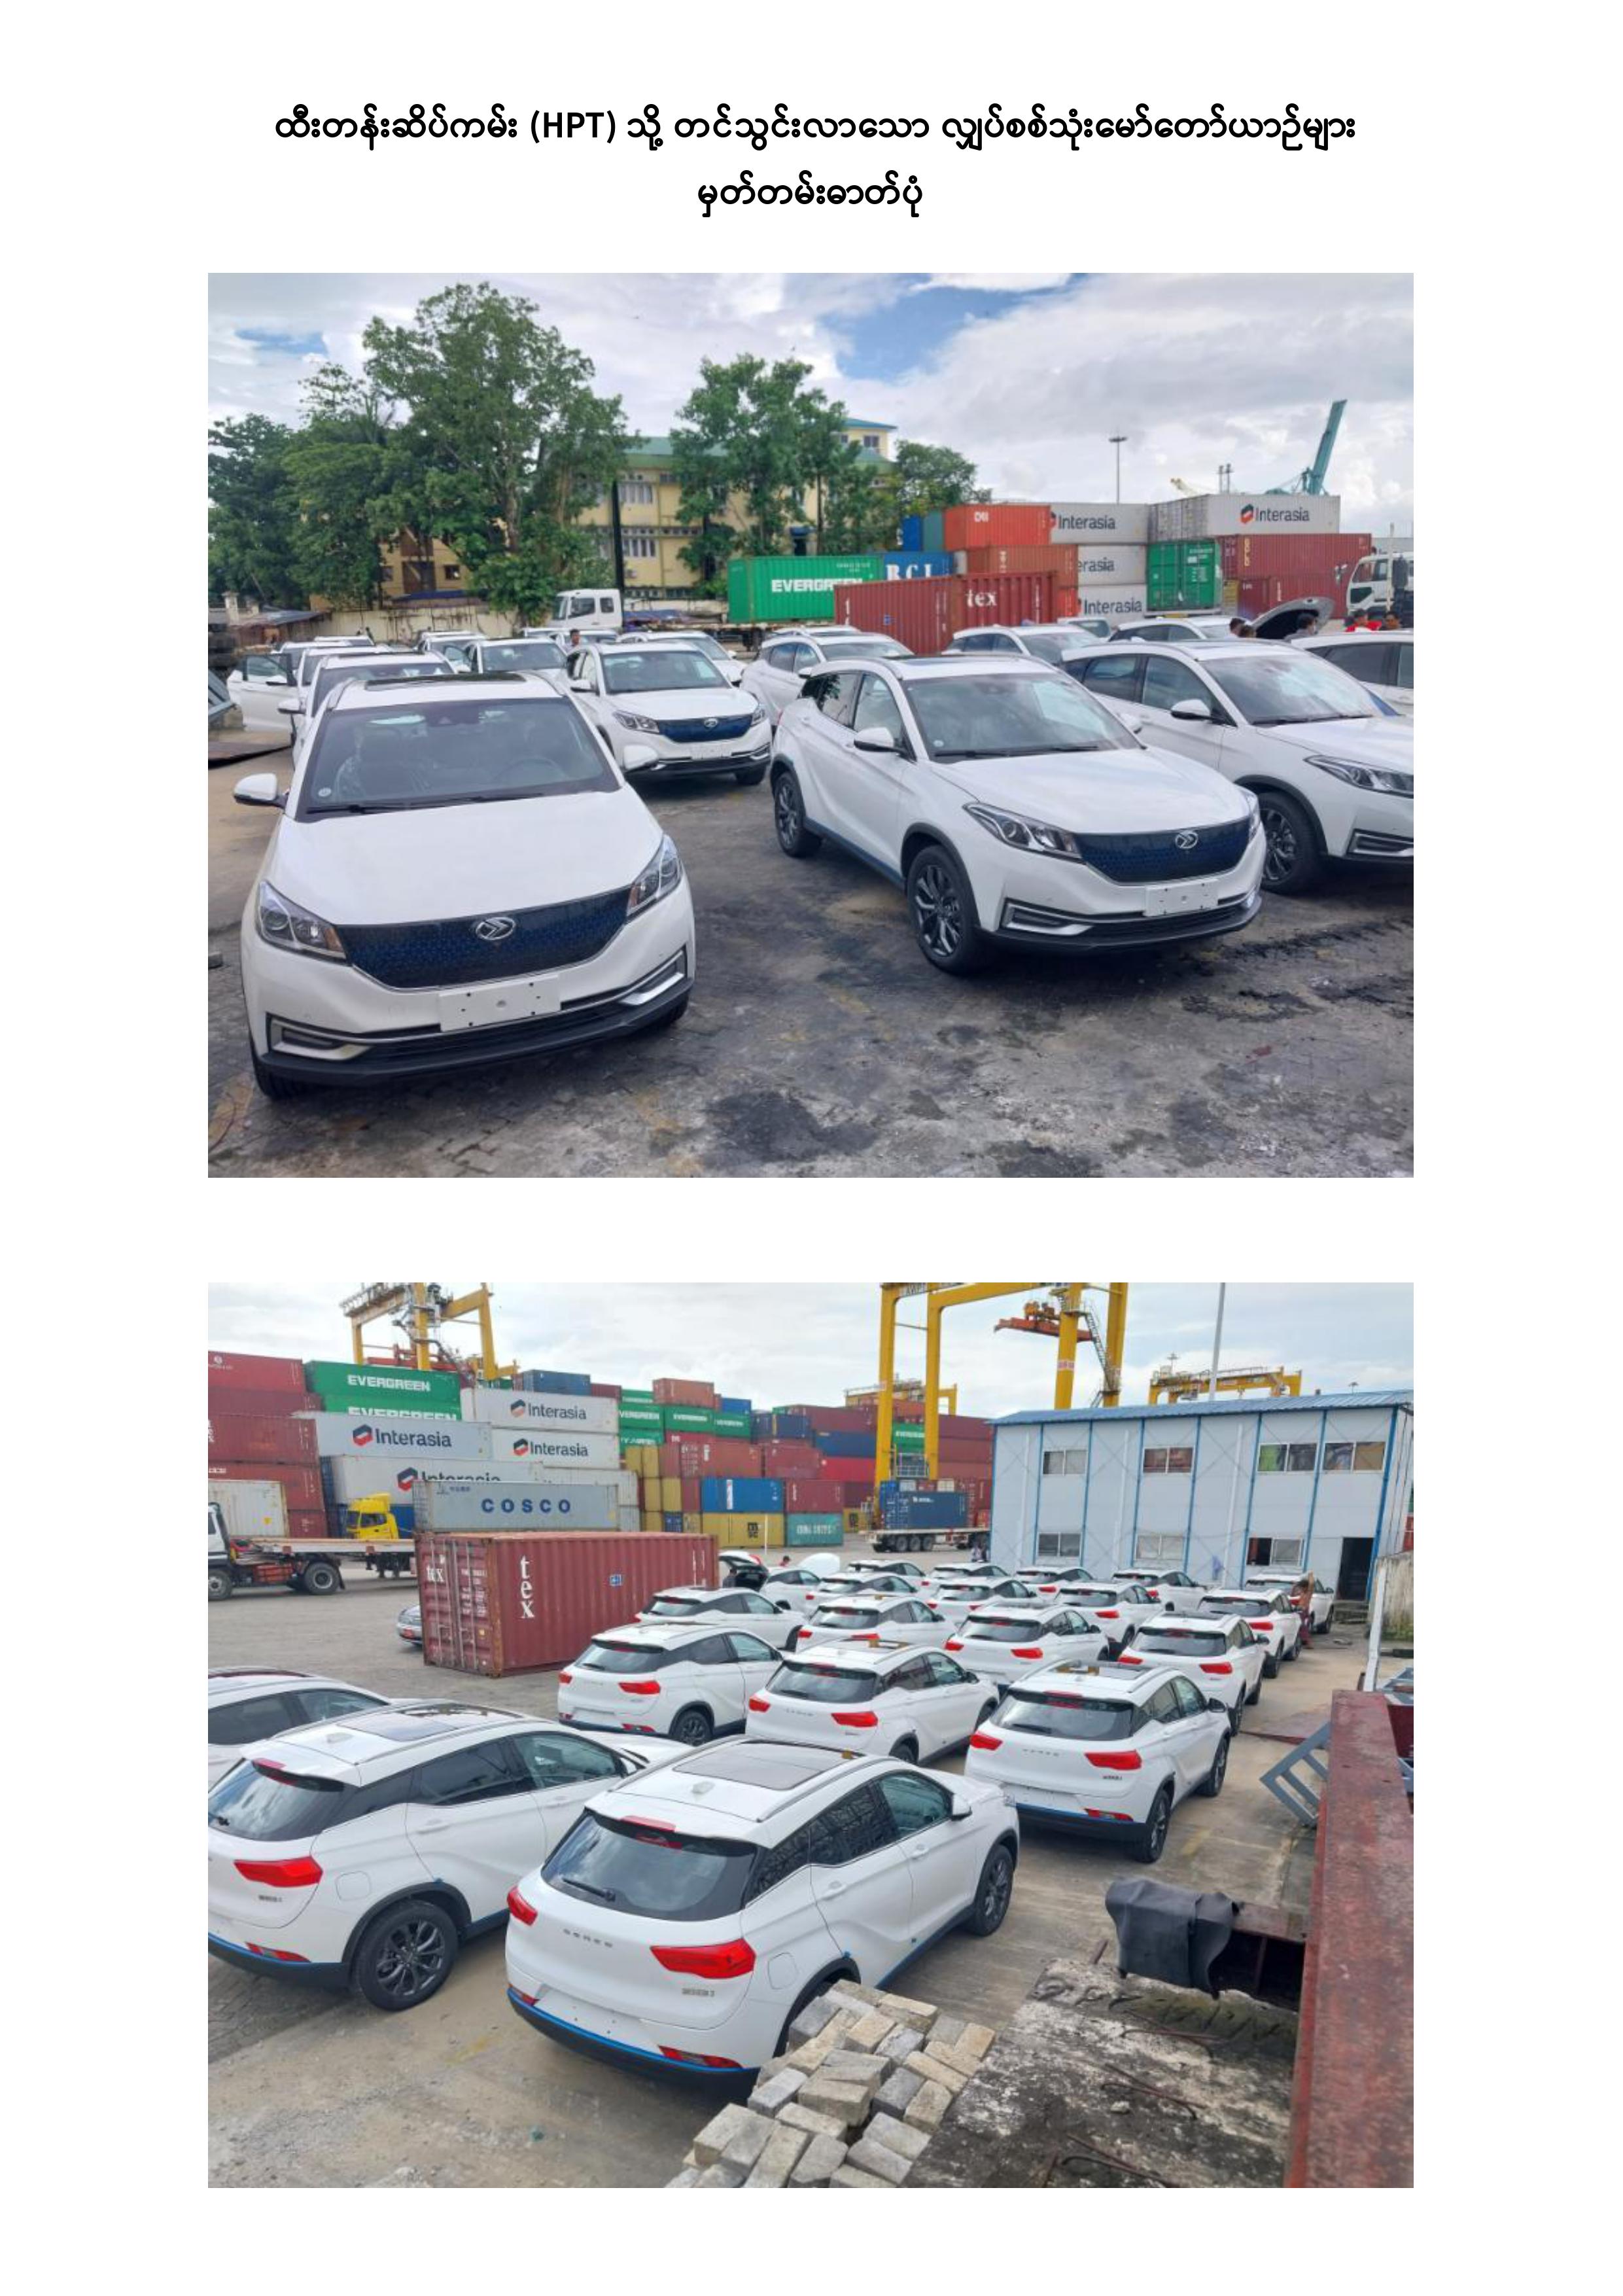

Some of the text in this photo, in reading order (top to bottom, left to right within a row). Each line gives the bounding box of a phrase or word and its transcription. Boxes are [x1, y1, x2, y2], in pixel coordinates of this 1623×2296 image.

[275, 103, 1355, 151] ထီးတန်းဆိပ်ကမ်း (HPT) သို့ တင်သွင်းလာသော လျှပ်စစ်သုံးမော်တော်ယာဉ်များ
[697, 169, 923, 218] မှတ်တမ်းဓာတ်ပုံ
[1058, 515, 1116, 529] Interasia
[1255, 507, 1310, 521] Interasia
[1078, 557, 1115, 572] erasia
[965, 589, 997, 607] tex
[1084, 597, 1142, 614] Interasia
[347, 1374, 431, 1392] EVERGREEN
[528, 1402, 587, 1419] Interasia
[375, 1428, 452, 1447] Interasia
[530, 1441, 589, 1457] Interasia
[481, 1498, 571, 1513] COSCO
[520, 1555, 535, 1619] tex
